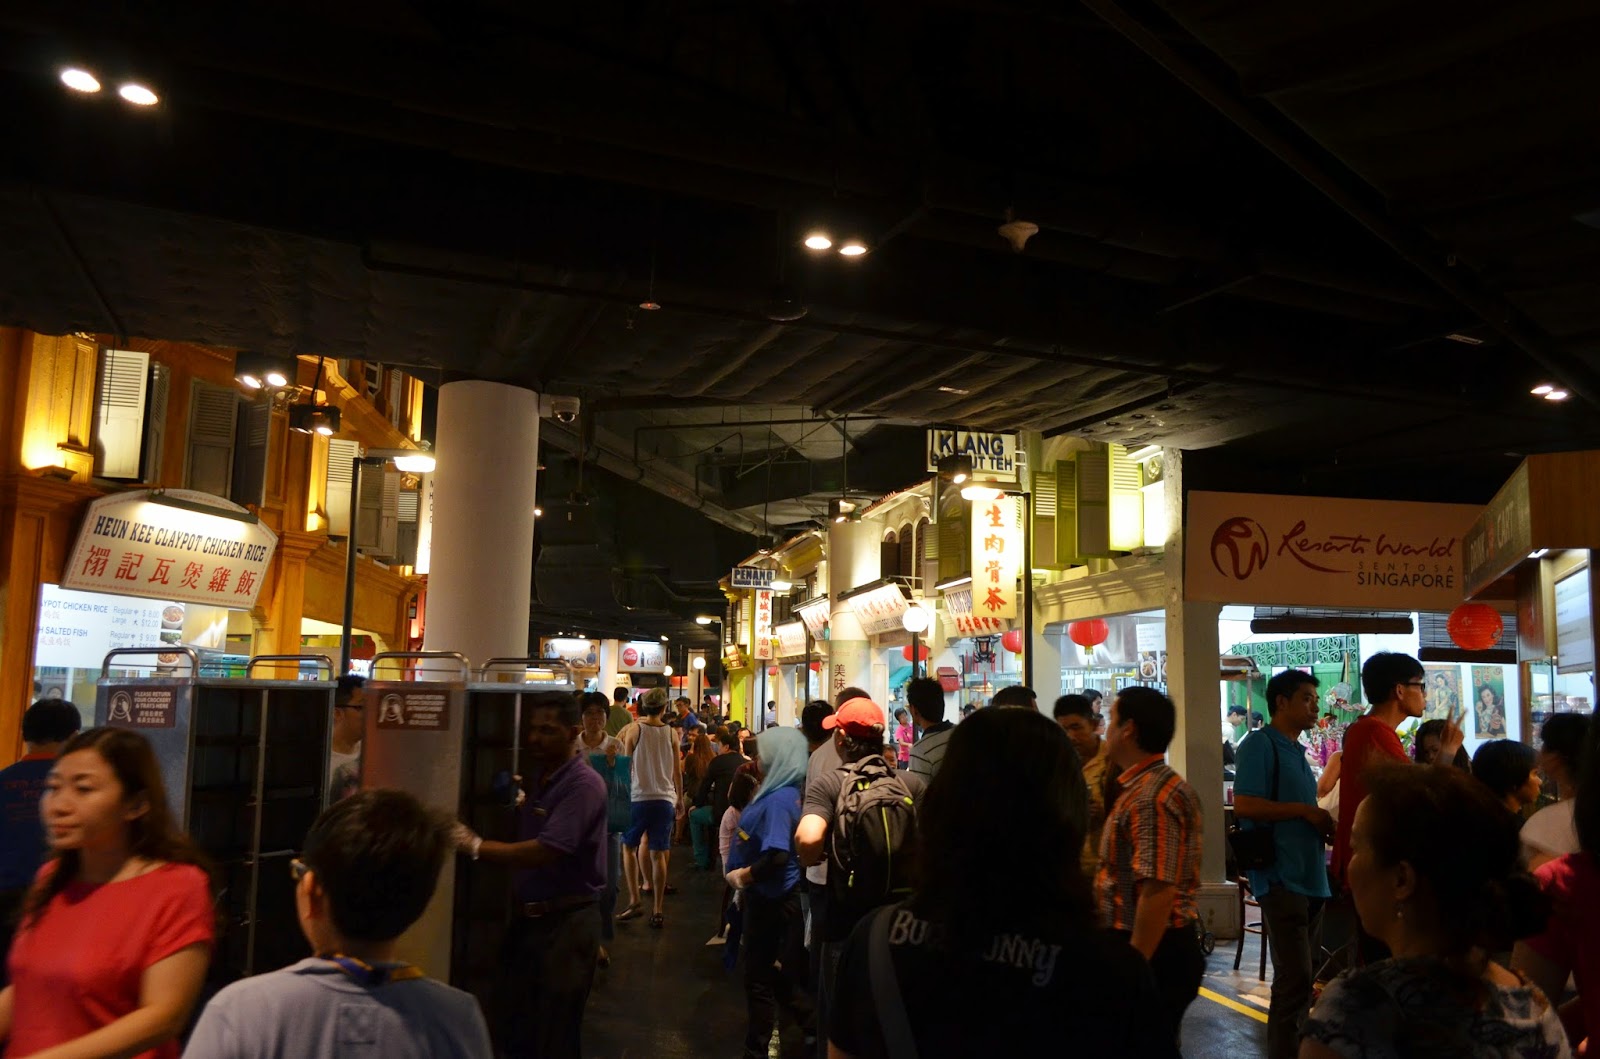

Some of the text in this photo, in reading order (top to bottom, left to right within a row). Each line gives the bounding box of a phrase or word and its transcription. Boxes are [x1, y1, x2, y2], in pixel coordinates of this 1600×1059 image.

[940, 432, 1004, 456] KANG
[989, 456, 1013, 471] TEH
[93, 515, 267, 563] HEUN KEE CLAYPOT CHICKEN RICE
[1277, 519, 1371, 574] Resorts
[1376, 533, 1456, 558] World
[983, 492, 1007, 613] 生肉骨茶
[1358, 560, 1454, 573] SENTOSA
[734, 569, 773, 581] PENANG
[1357, 571, 1455, 589] SINGAPORE
[41, 599, 109, 614] YPOT CHICKEN RICE
[45, 627, 72, 637] SALTED
[73, 628, 88, 637] FISH
